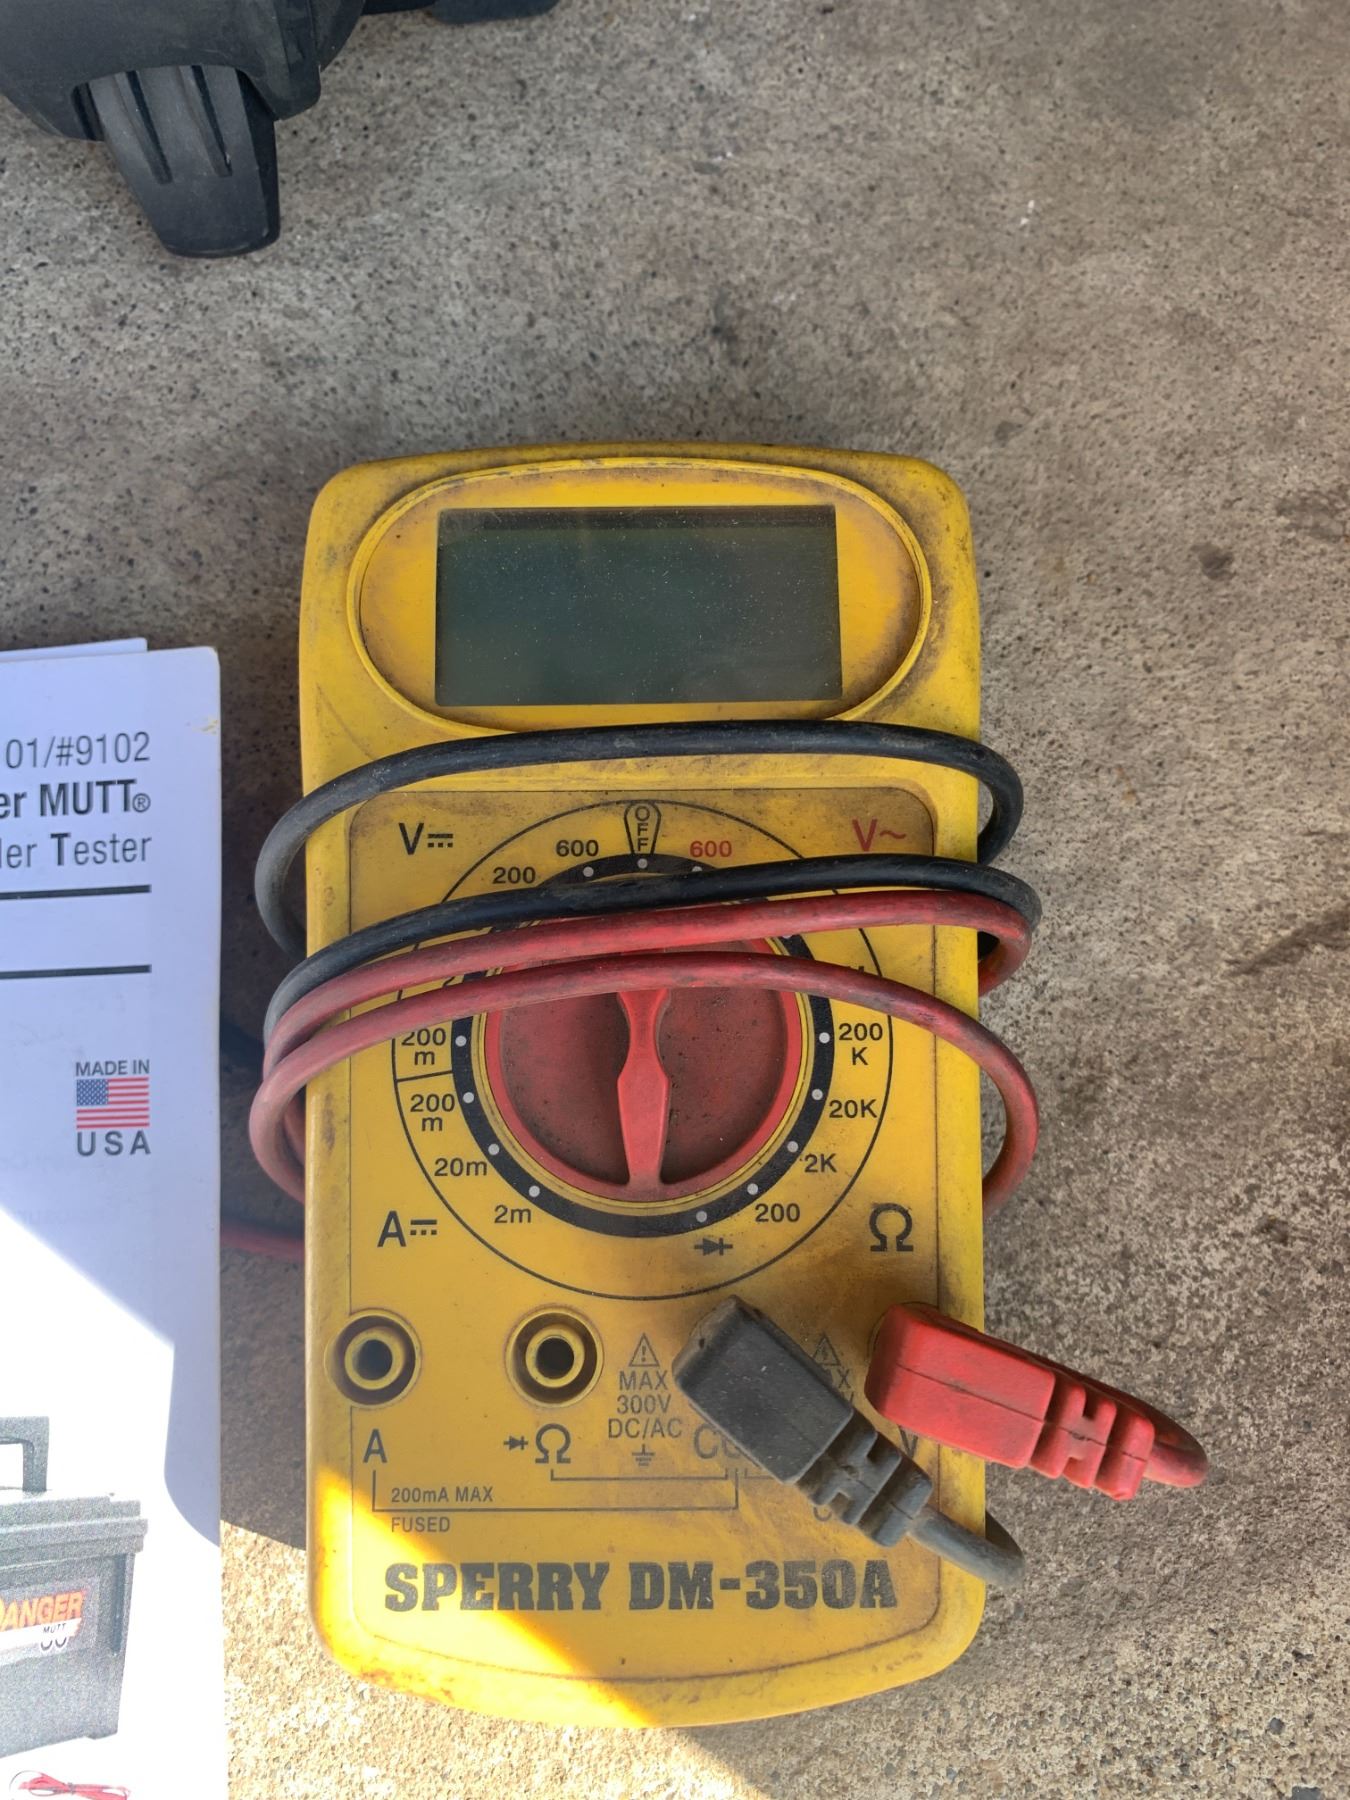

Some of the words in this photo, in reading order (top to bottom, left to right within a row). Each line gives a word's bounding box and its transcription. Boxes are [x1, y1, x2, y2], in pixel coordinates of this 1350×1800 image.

[633, 805, 651, 853] OFF
[50, 832, 152, 867] Tester
[555, 839, 600, 858] 600
[688, 840, 733, 859] 600
[491, 866, 537, 885] 200
[401, 1027, 447, 1047] 200
[838, 1022, 884, 1042] 200
[414, 1050, 436, 1066] m
[851, 1046, 869, 1066] K
[75, 1062, 127, 1077] MADE
[131, 1060, 150, 1076] IN
[409, 1094, 455, 1114] 200
[828, 1100, 877, 1120] 20K
[421, 1117, 444, 1133] m
[77, 1130, 151, 1156] USA
[433, 1159, 488, 1178] 20m
[804, 1154, 838, 1174] 2K
[493, 1206, 532, 1225] 2m
[754, 1204, 800, 1224] 200
[618, 1370, 669, 1391] MAX
[616, 1393, 672, 1415] 300V
[607, 1417, 683, 1440] DC/AC
[362, 1428, 388, 1463] A
[391, 1487, 450, 1503] 200mA
[454, 1486, 494, 1503] MAX
[390, 1516, 451, 1533] FUSED
[384, 1561, 610, 1611] SPERRY
[627, 1558, 898, 1612] DM-350A
[43, 1622, 67, 1634] MUTT
